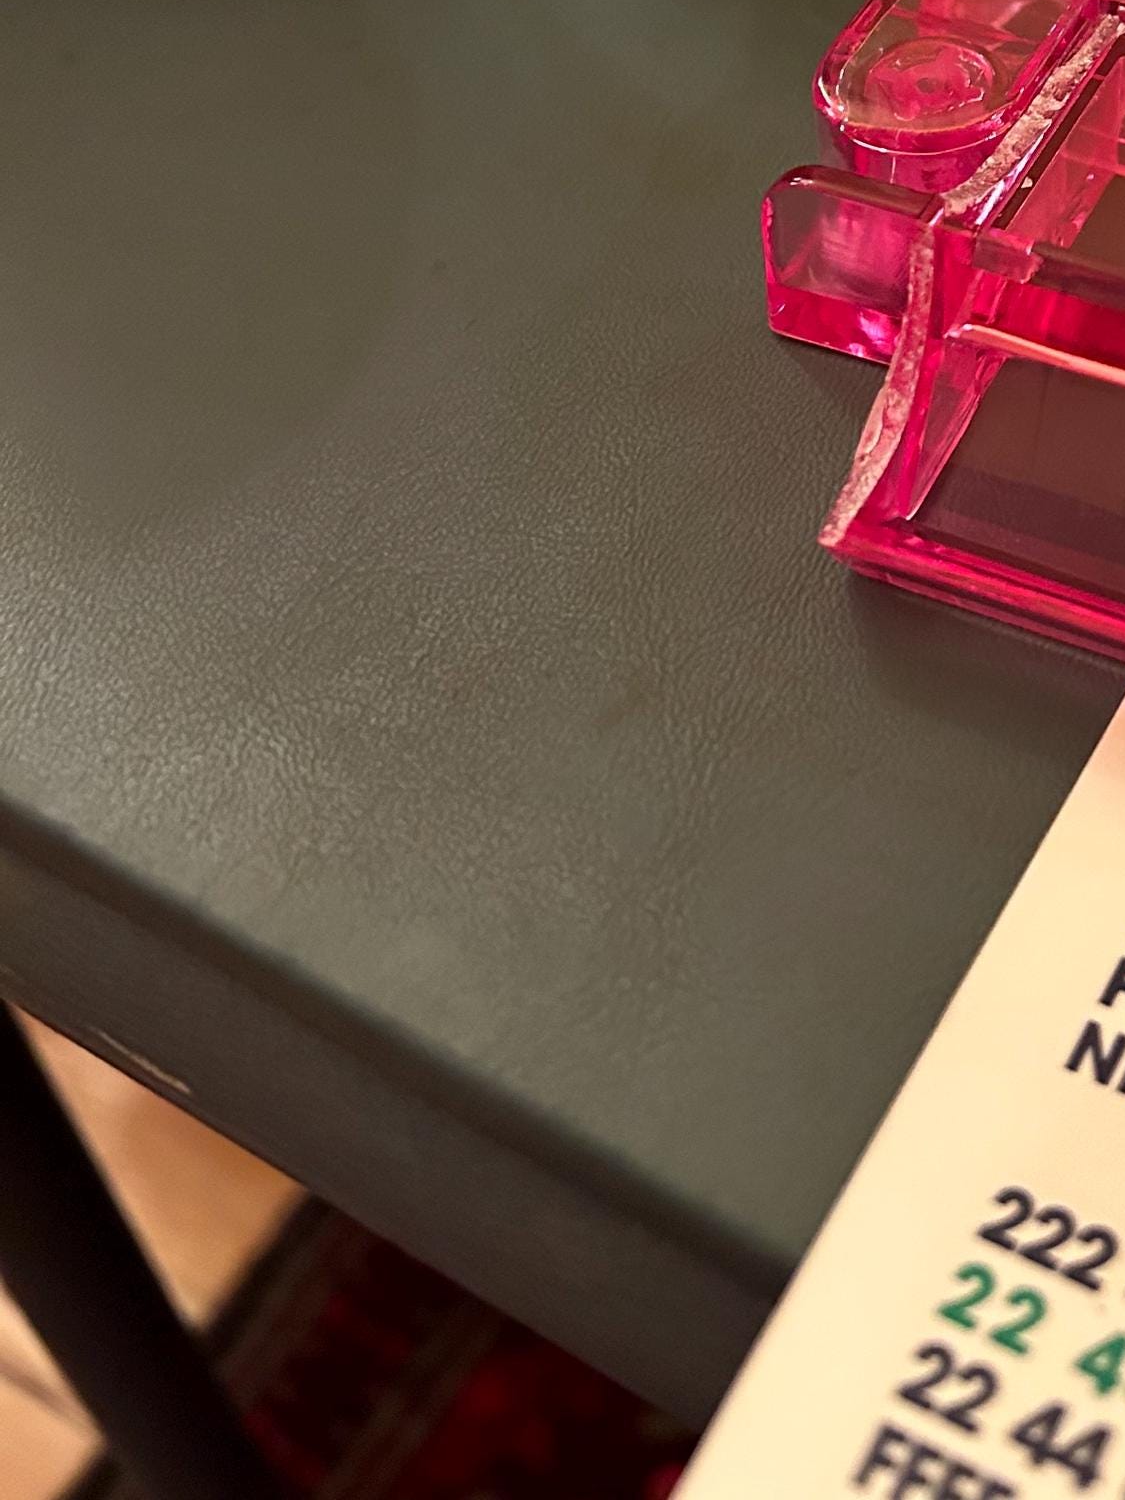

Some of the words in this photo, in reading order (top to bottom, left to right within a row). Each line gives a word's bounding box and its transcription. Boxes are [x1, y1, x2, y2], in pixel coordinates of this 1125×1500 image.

[978, 1186, 1119, 1291] 222
[937, 1261, 1048, 1356] 22
[852, 1423, 1016, 1500] FFF
[896, 1342, 999, 1434] 22
[1011, 1403, 1112, 1488] 44
